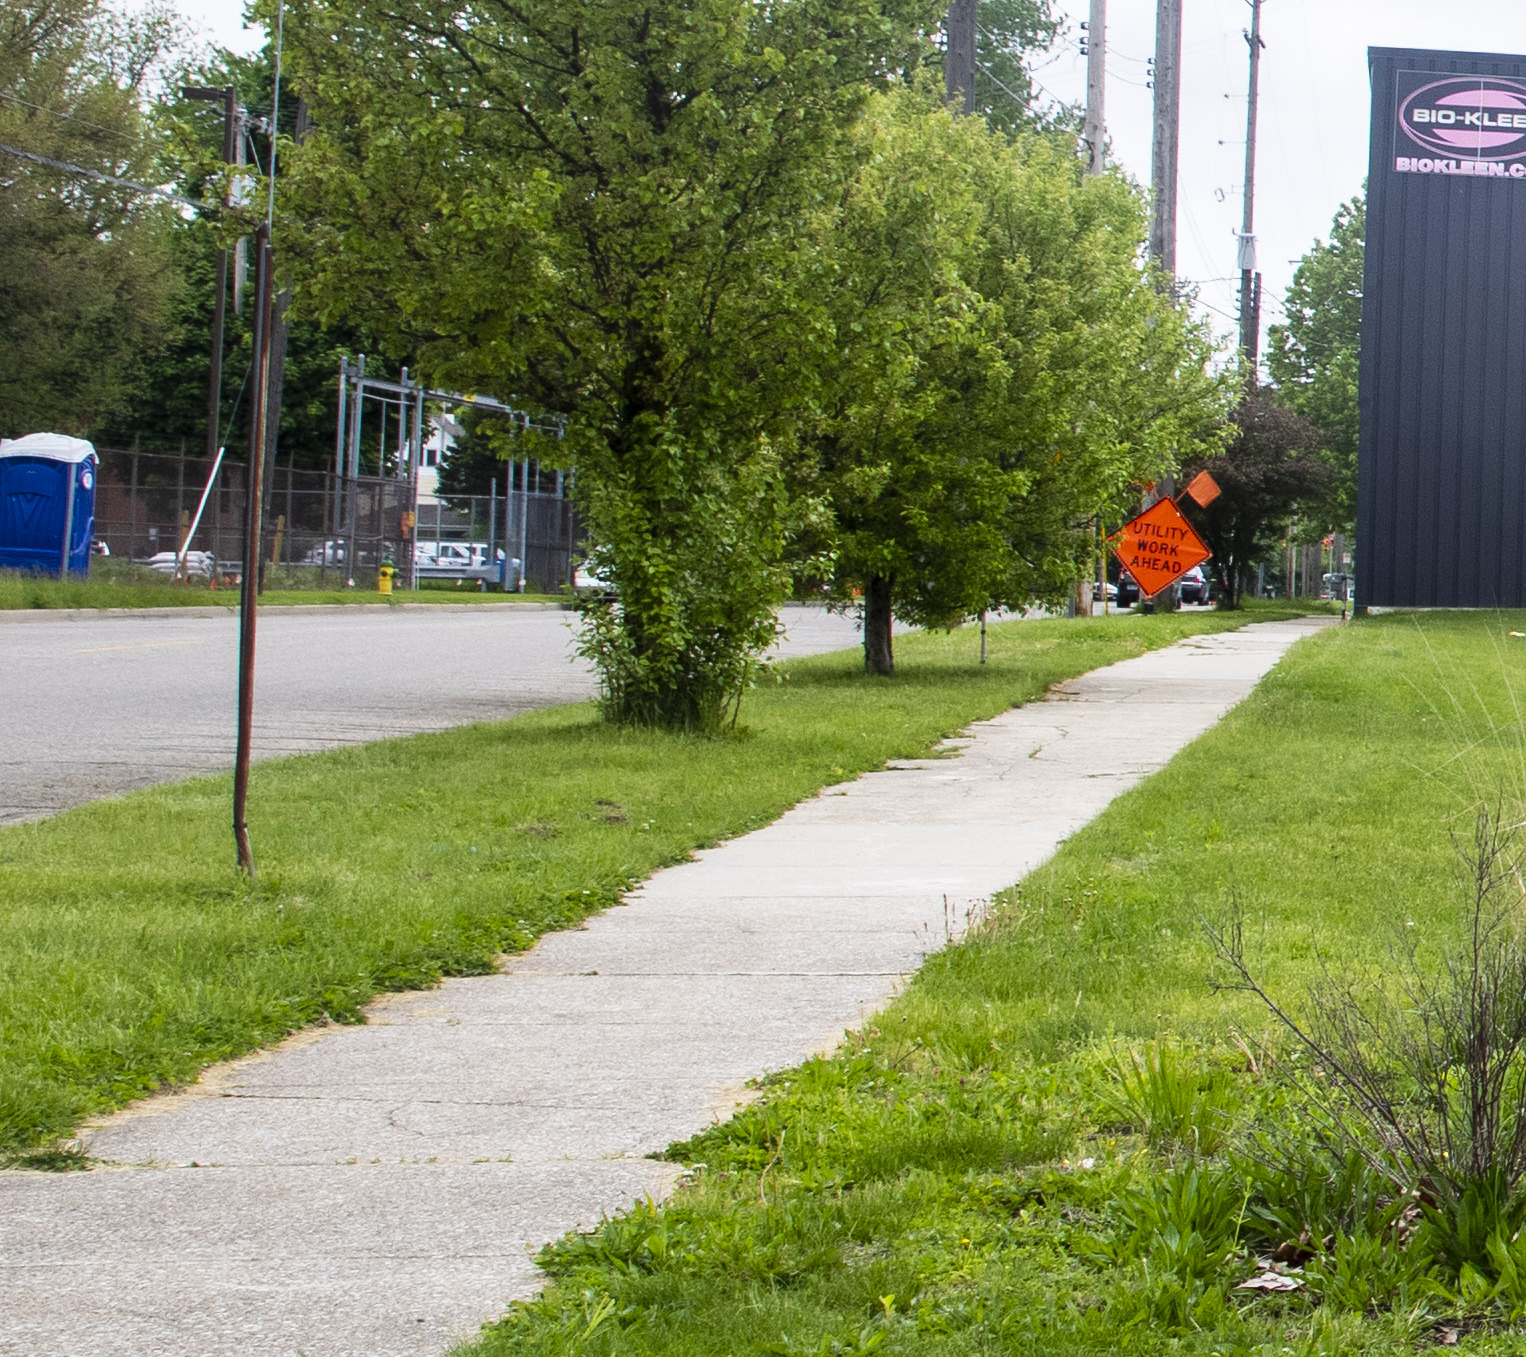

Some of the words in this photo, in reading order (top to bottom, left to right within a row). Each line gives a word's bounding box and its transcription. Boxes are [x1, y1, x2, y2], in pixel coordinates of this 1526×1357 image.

[1133, 521, 1189, 541] UTILITY
[1137, 539, 1180, 557] WORK
[1130, 555, 1182, 574] AHEAD
